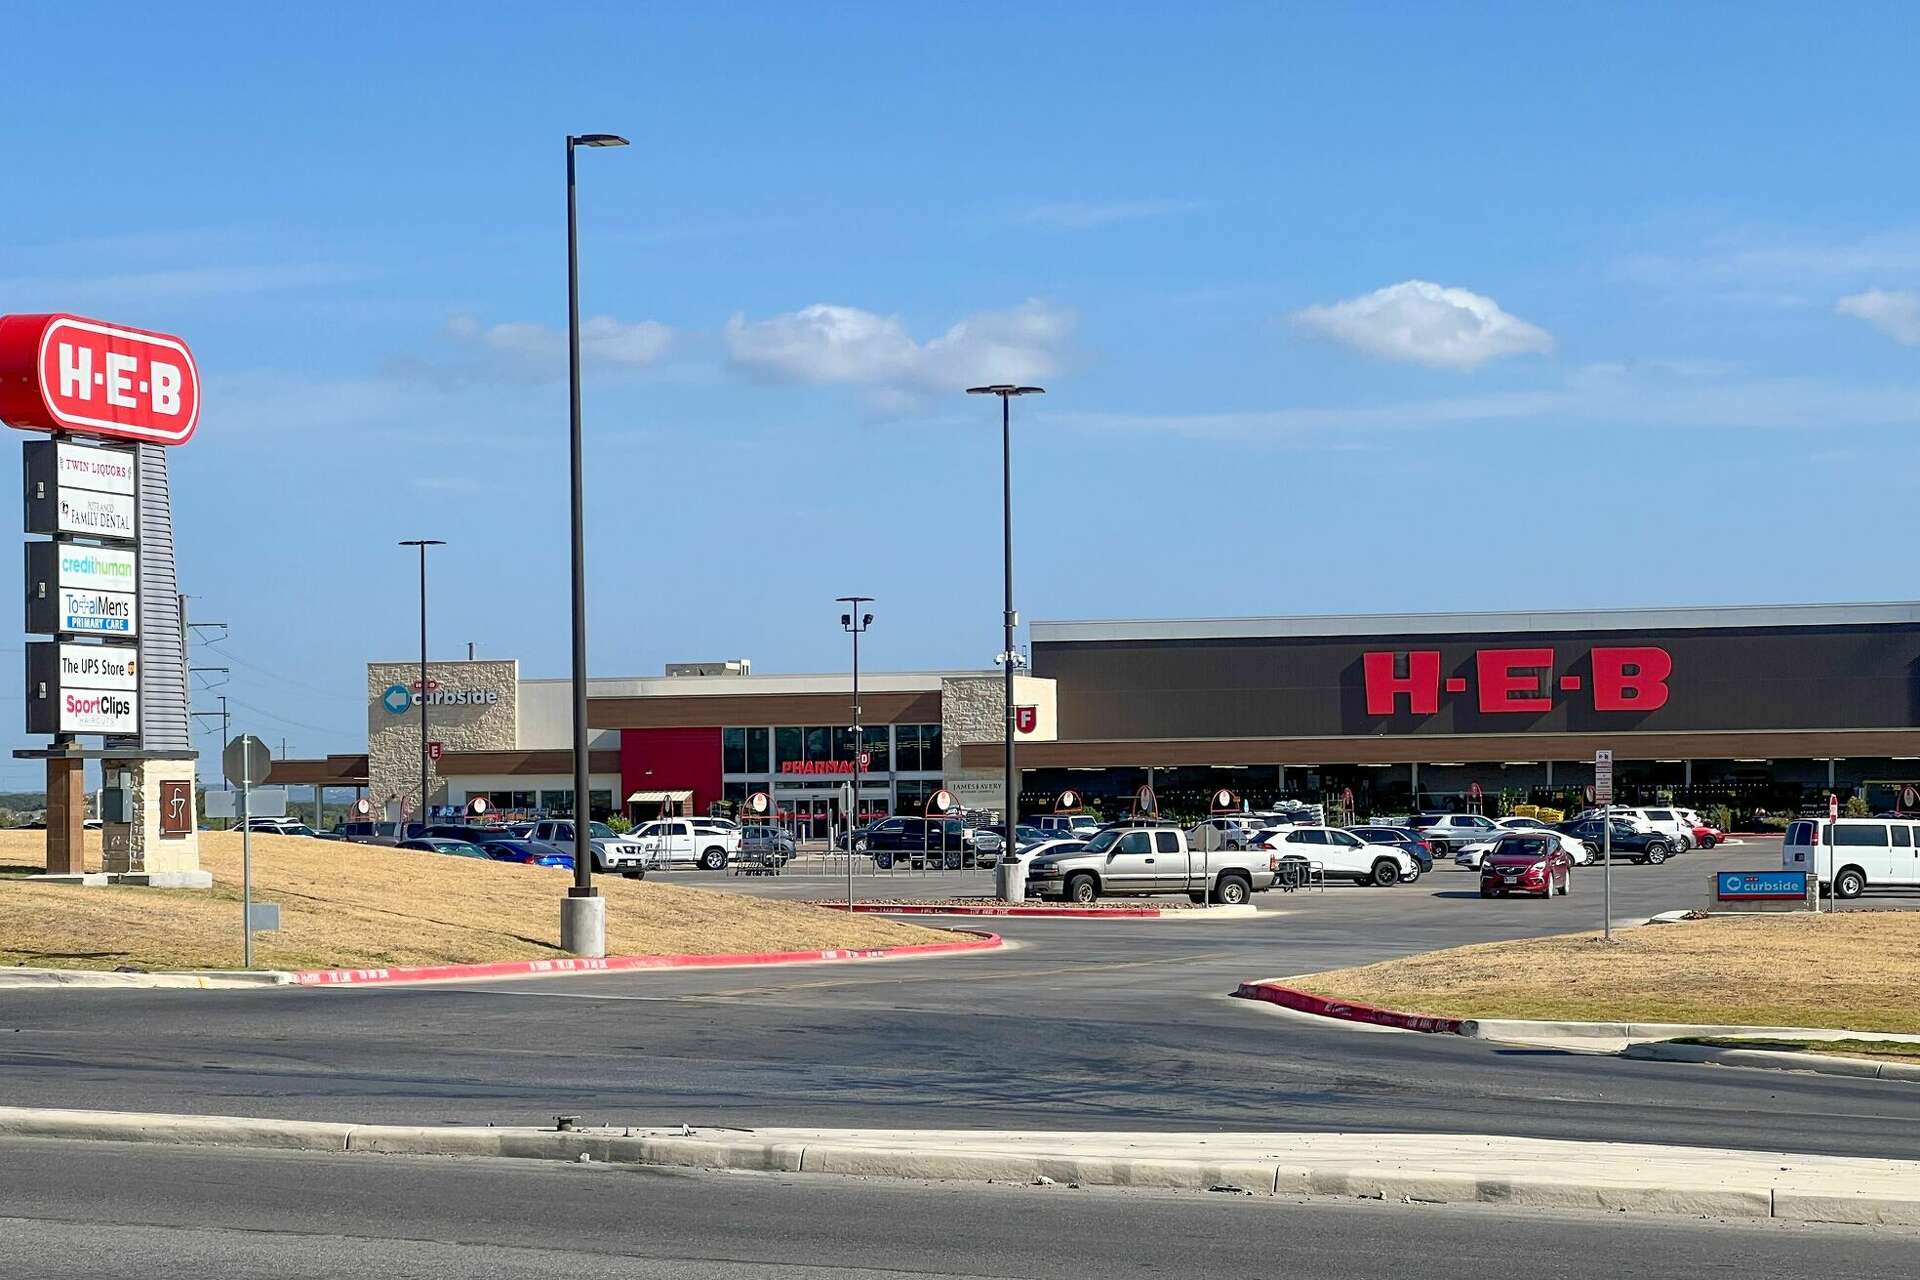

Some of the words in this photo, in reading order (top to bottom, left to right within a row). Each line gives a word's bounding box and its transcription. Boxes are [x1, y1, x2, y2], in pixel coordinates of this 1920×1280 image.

[66, 459, 89, 472] TWIN
[92, 462, 126, 477] LIQUORS
[71, 509, 98, 526] FAMILY
[100, 512, 130, 530] DENTAL
[62, 555, 132, 577] credithuman
[71, 617, 103, 630] PRIMARY
[105, 618, 124, 630] CARE
[62, 657, 79, 674] The
[81, 659, 99, 674] UPS
[102, 660, 124, 676] Store
[411, 689, 497, 705] curbside
[1021, 711, 1031, 727] F
[431, 745, 438, 757] E
[861, 754, 868, 763] D
[1744, 881, 1799, 891] curbside
